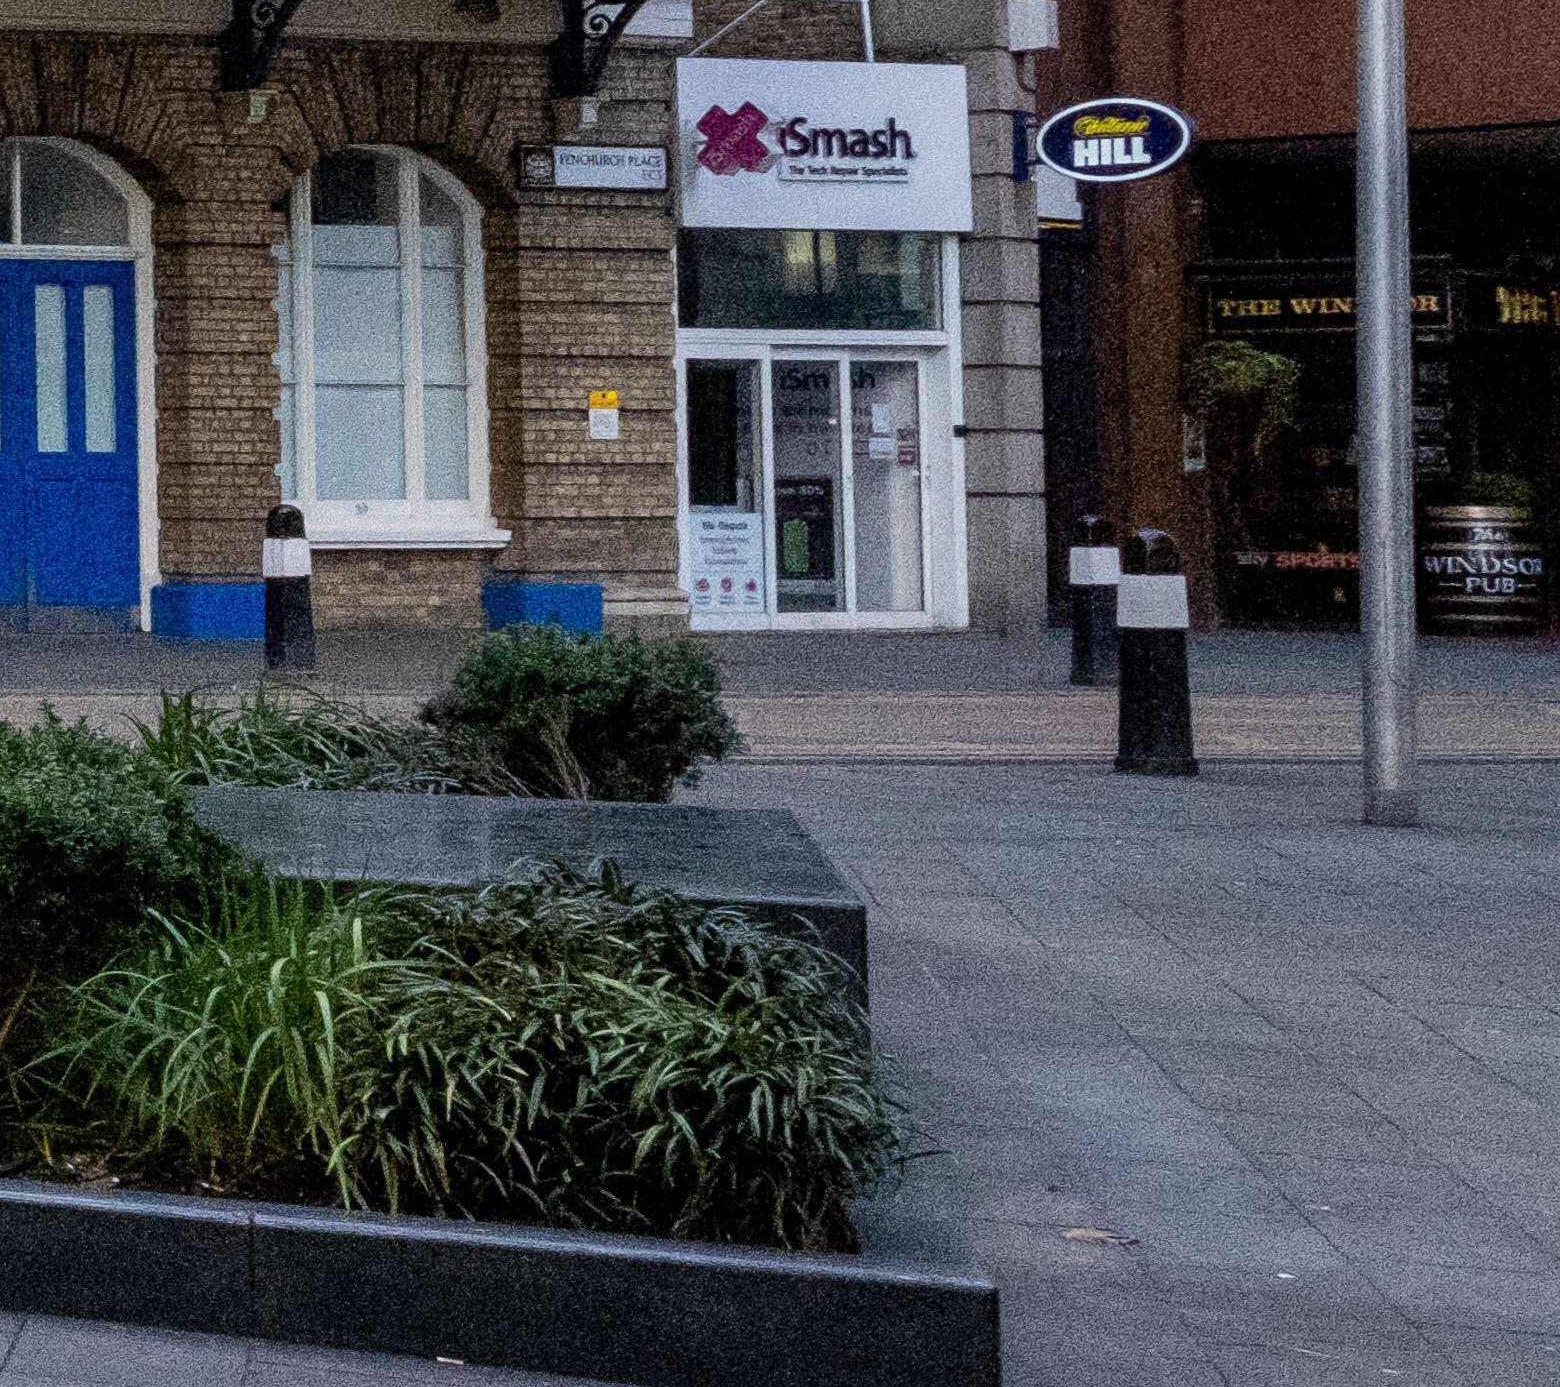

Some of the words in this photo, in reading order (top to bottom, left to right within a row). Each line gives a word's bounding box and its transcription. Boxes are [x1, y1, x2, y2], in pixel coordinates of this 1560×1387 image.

[779, 115, 914, 159] iSmash
[558, 153, 625, 167] FENCHURCH
[627, 155, 663, 168] PLACE
[1072, 137, 1153, 168] HILL
[789, 164, 806, 176] The
[807, 164, 828, 176] Tech
[1216, 297, 1283, 318] THE
[1289, 293, 1440, 317] WINR
[779, 367, 876, 391] iSmh
[1463, 577, 1516, 594] PUB
